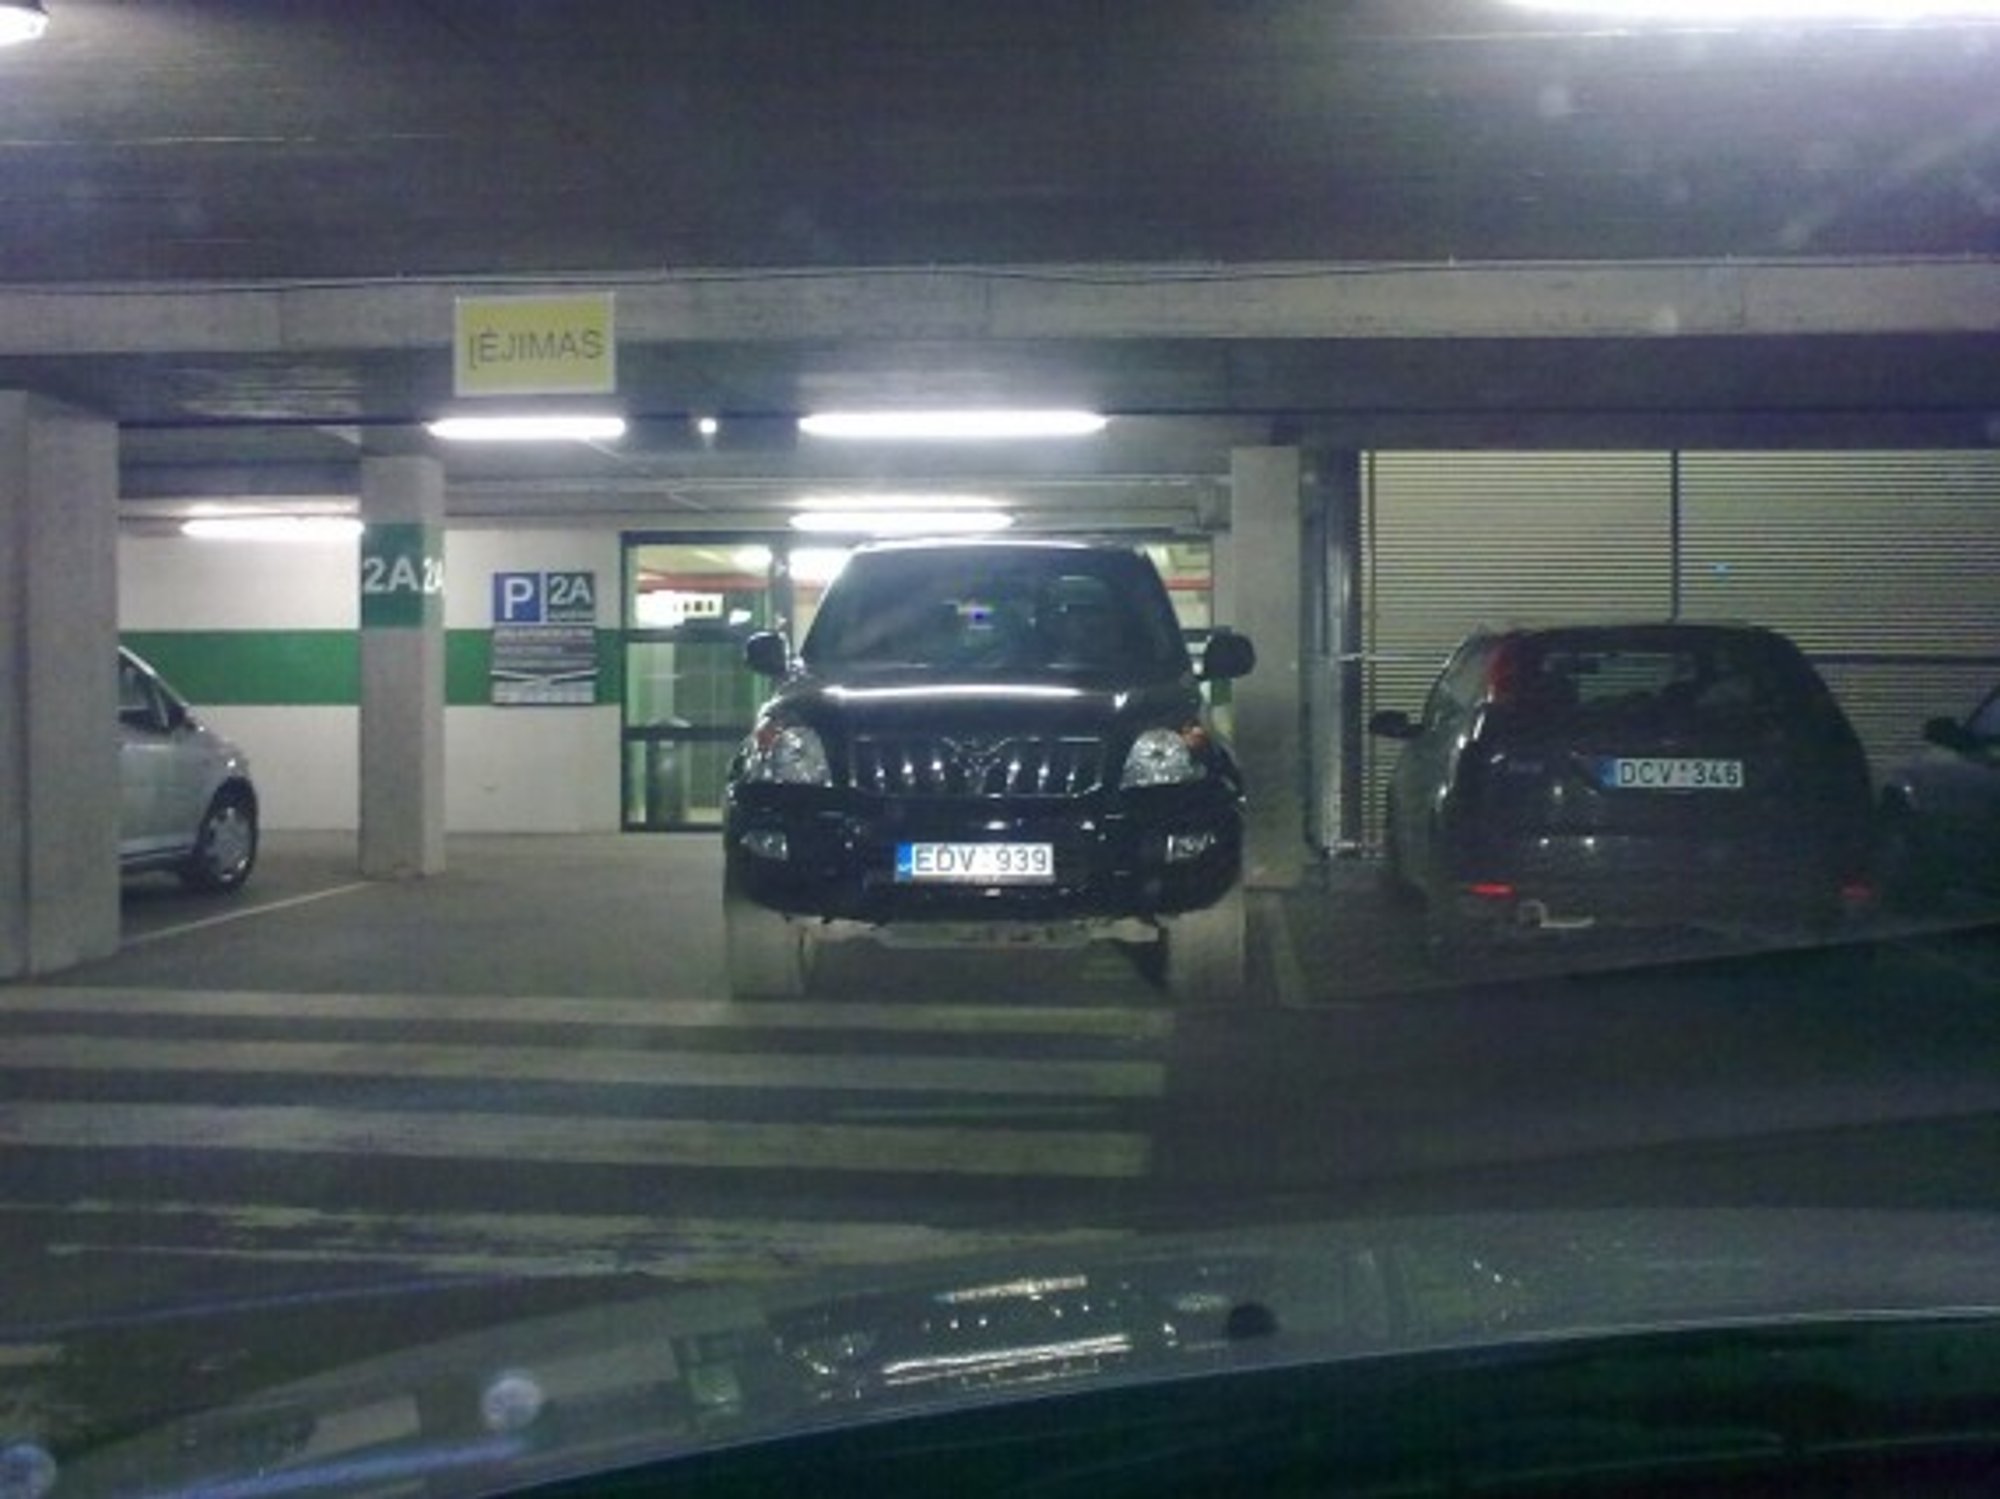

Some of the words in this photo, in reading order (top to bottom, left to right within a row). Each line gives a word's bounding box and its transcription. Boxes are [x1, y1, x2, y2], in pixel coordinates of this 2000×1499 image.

[469, 326, 604, 371] ĮĖJIMAS
[363, 556, 419, 593] 2A
[549, 575, 592, 606] 2A
[504, 577, 534, 620] P
[1620, 761, 1675, 784] DCV
[1693, 761, 1738, 784] 346
[915, 849, 976, 872] EDV
[995, 849, 1047, 872] 939
